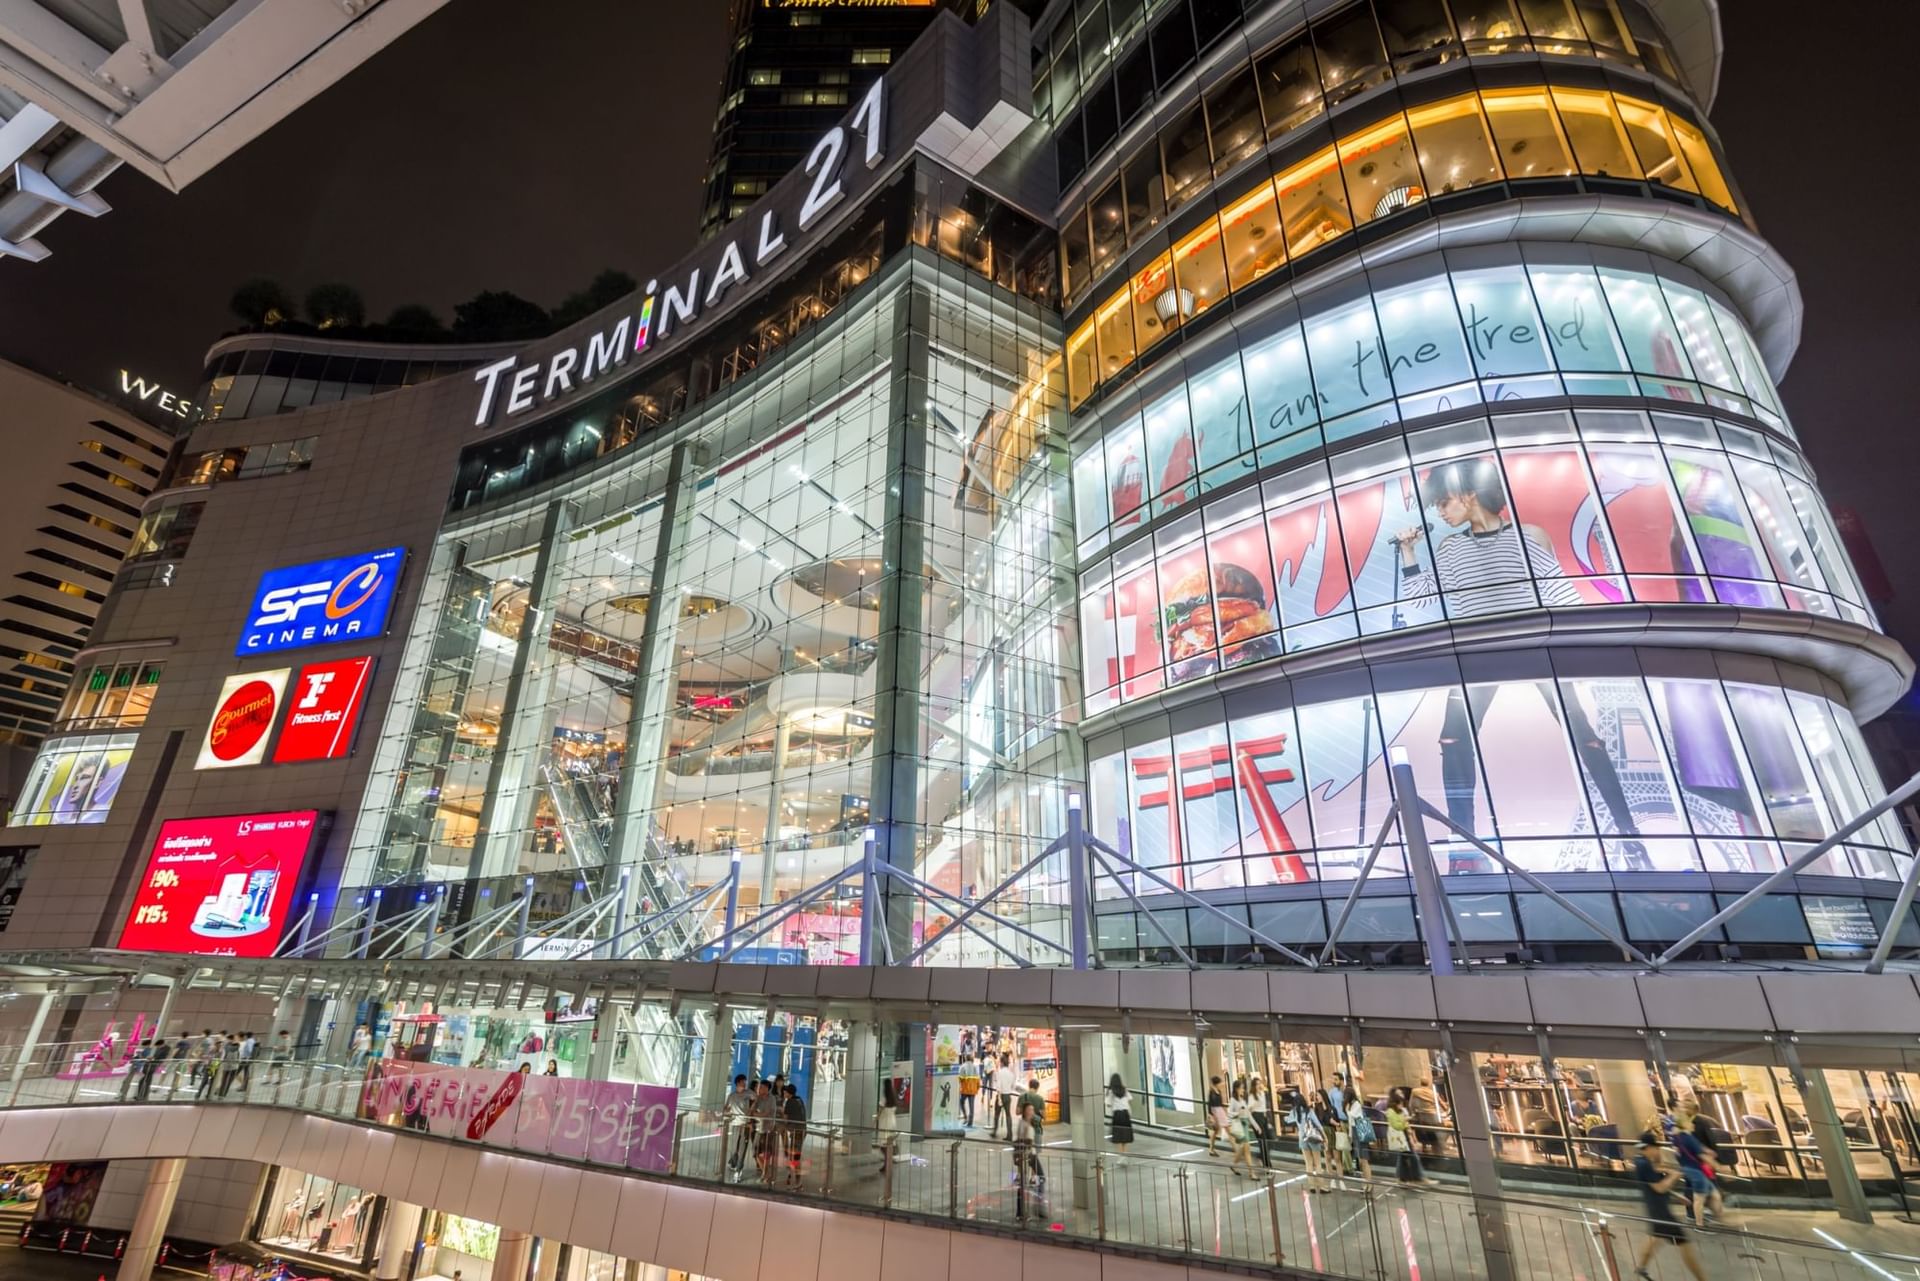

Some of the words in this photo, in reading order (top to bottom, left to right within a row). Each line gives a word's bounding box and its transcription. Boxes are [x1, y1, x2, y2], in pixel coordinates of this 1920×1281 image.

[799, 76, 886, 231] 21
[1269, 389, 1328, 432] am
[1353, 337, 1441, 397] the
[248, 620, 361, 647] CINEMA
[292, 713, 321, 726] Fitness
[321, 710, 341, 723] First
[540, 942, 578, 953] TERMiNL
[592, 1102, 669, 1152] SEP
